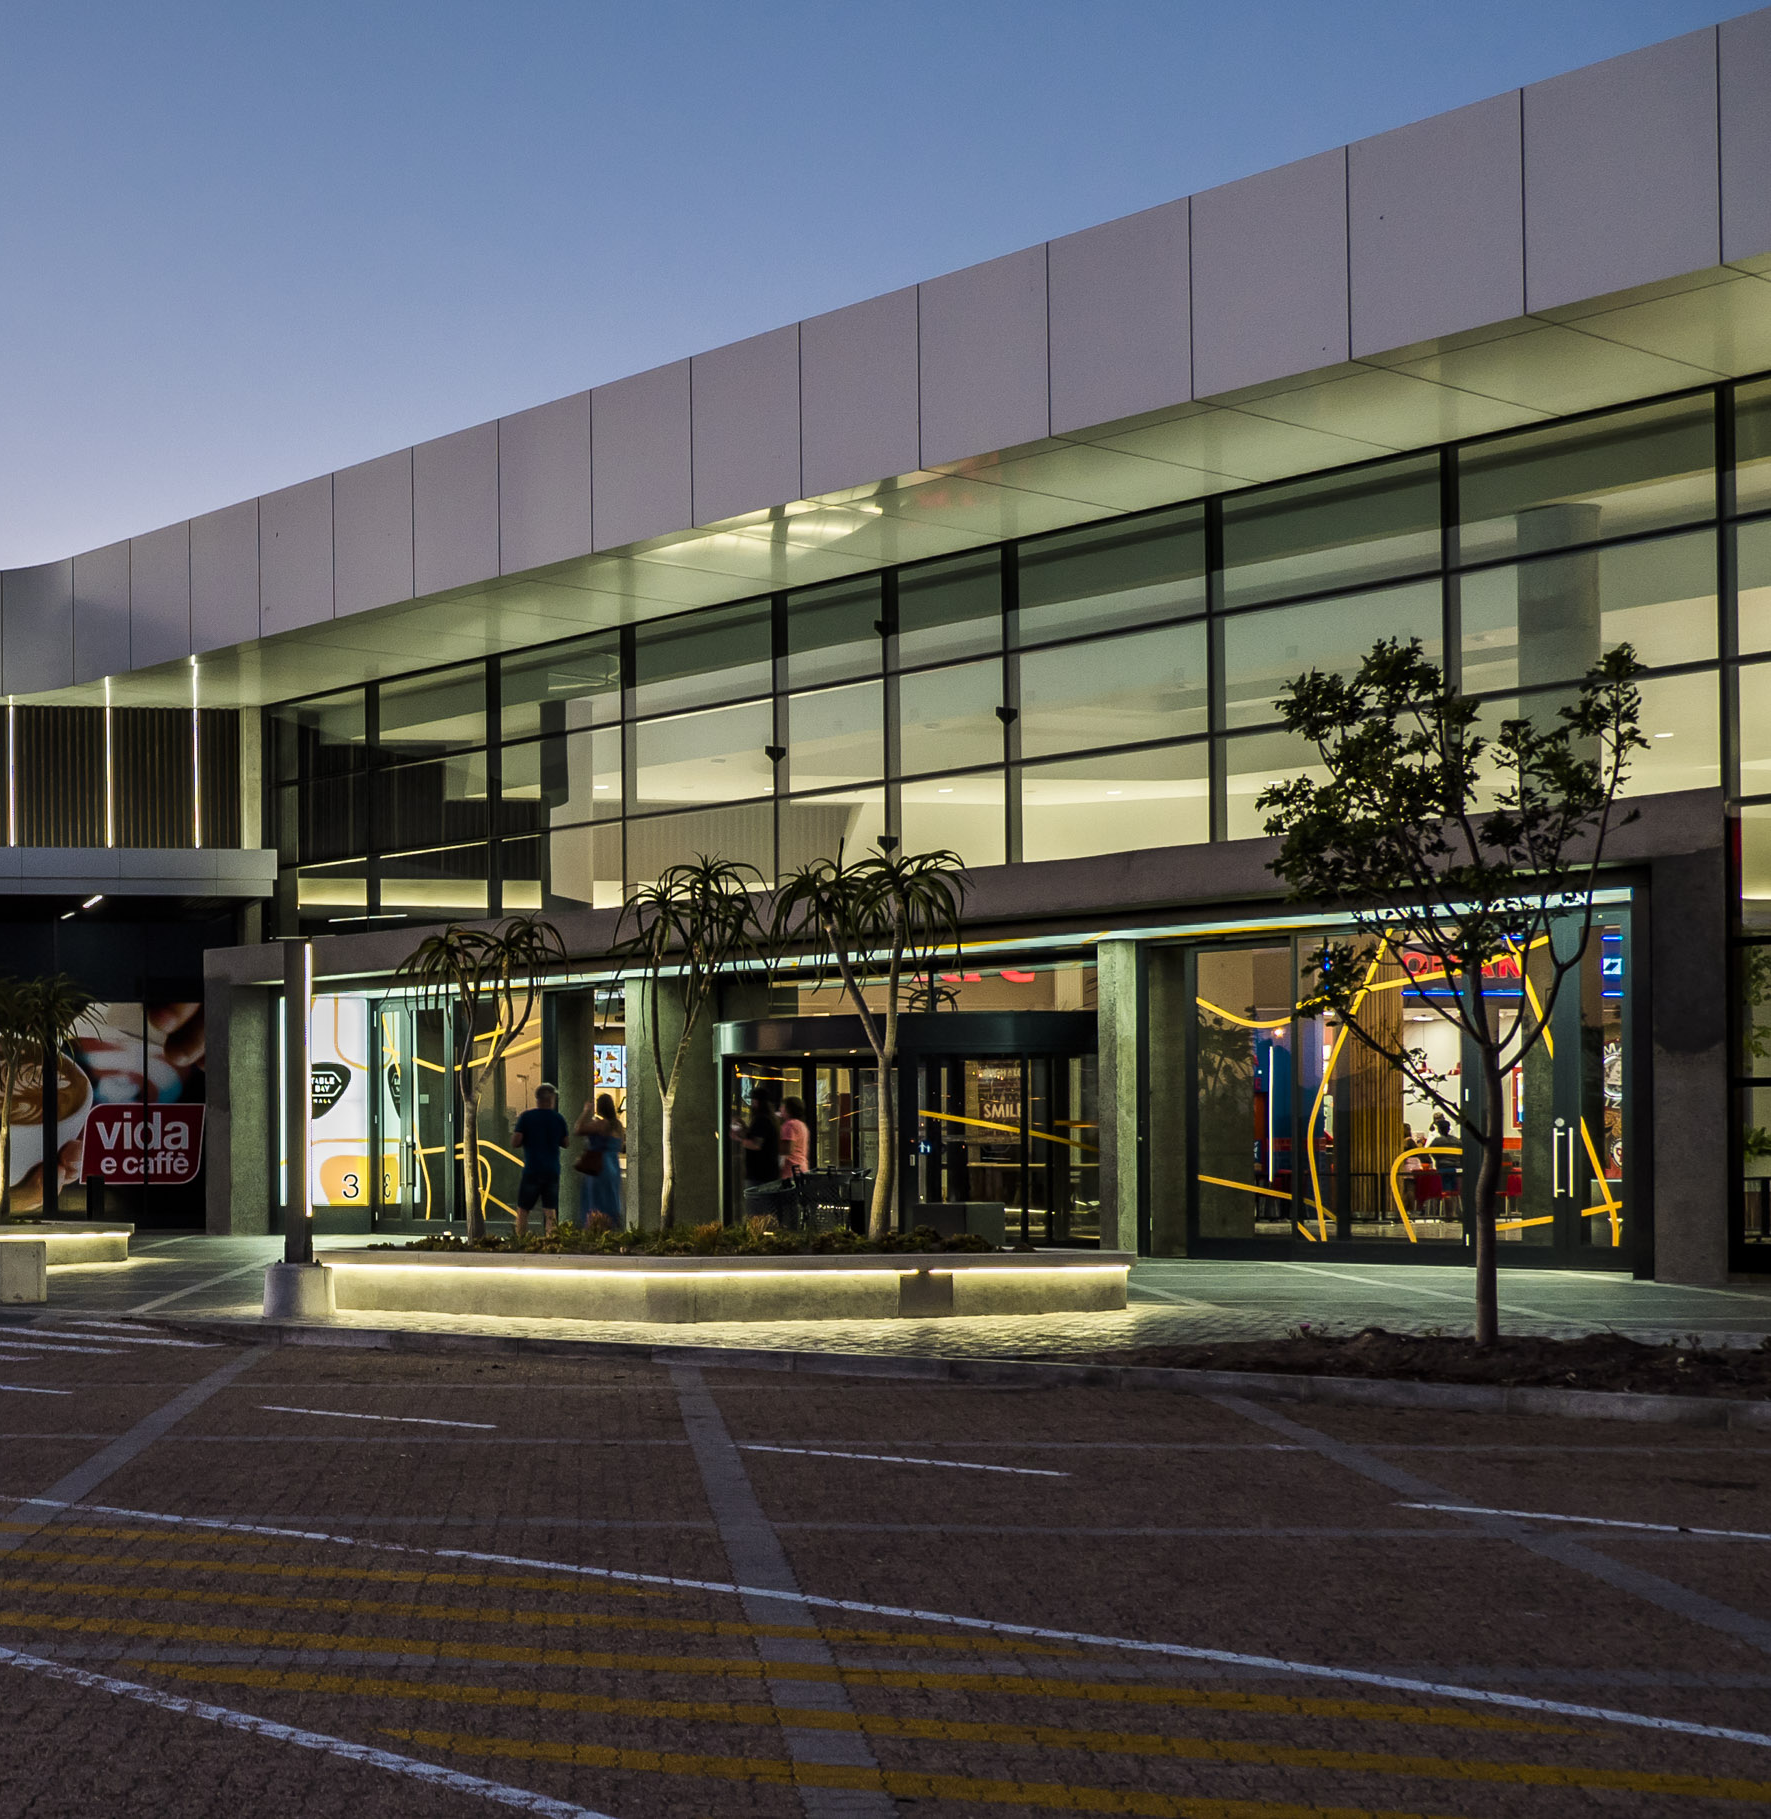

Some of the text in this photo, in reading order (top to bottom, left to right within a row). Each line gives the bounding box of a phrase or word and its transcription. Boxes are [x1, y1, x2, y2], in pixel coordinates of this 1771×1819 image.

[311, 1077, 335, 1085] TABLE
[314, 1085, 330, 1093] BAY
[95, 1111, 189, 1150] vida
[100, 1151, 189, 1175] e caffè
[343, 1173, 360, 1199] 3
